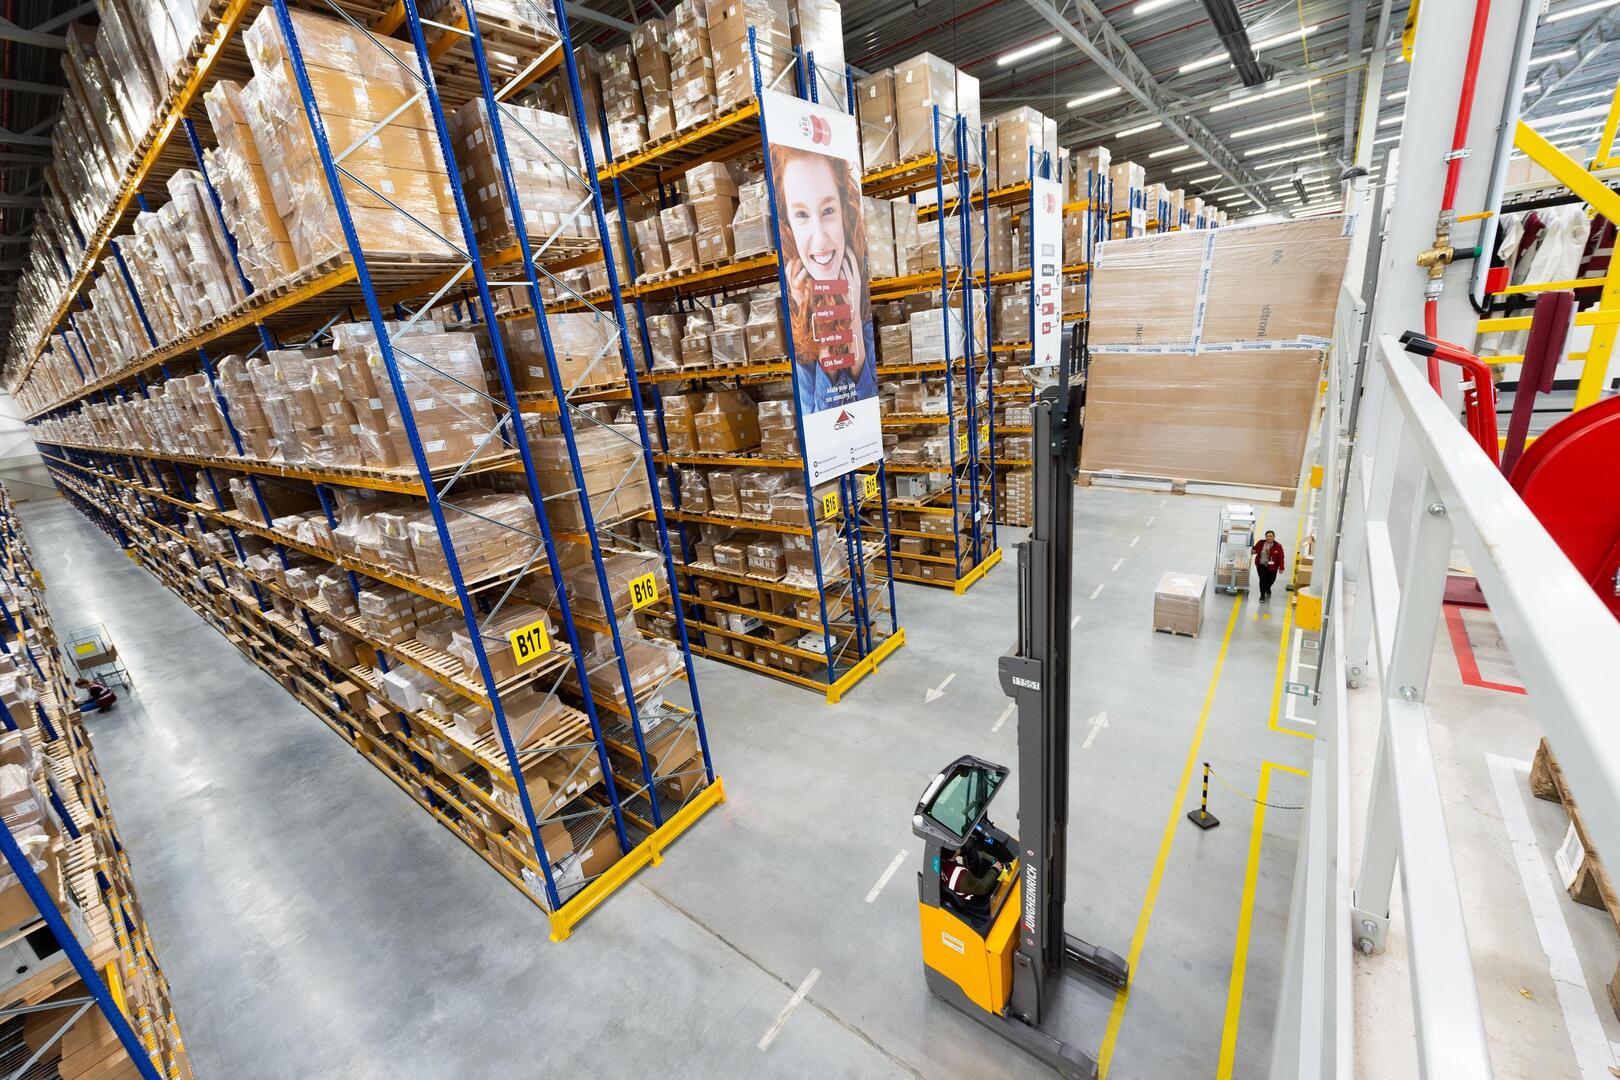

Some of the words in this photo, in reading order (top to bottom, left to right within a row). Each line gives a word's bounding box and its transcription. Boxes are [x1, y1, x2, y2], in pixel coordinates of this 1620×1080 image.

[825, 495, 836, 513] B16
[633, 578, 654, 603] B16
[516, 627, 542, 658] B17
[1012, 676, 1040, 691] 11551
[1023, 863, 1038, 934] JUNGHEINRICH
